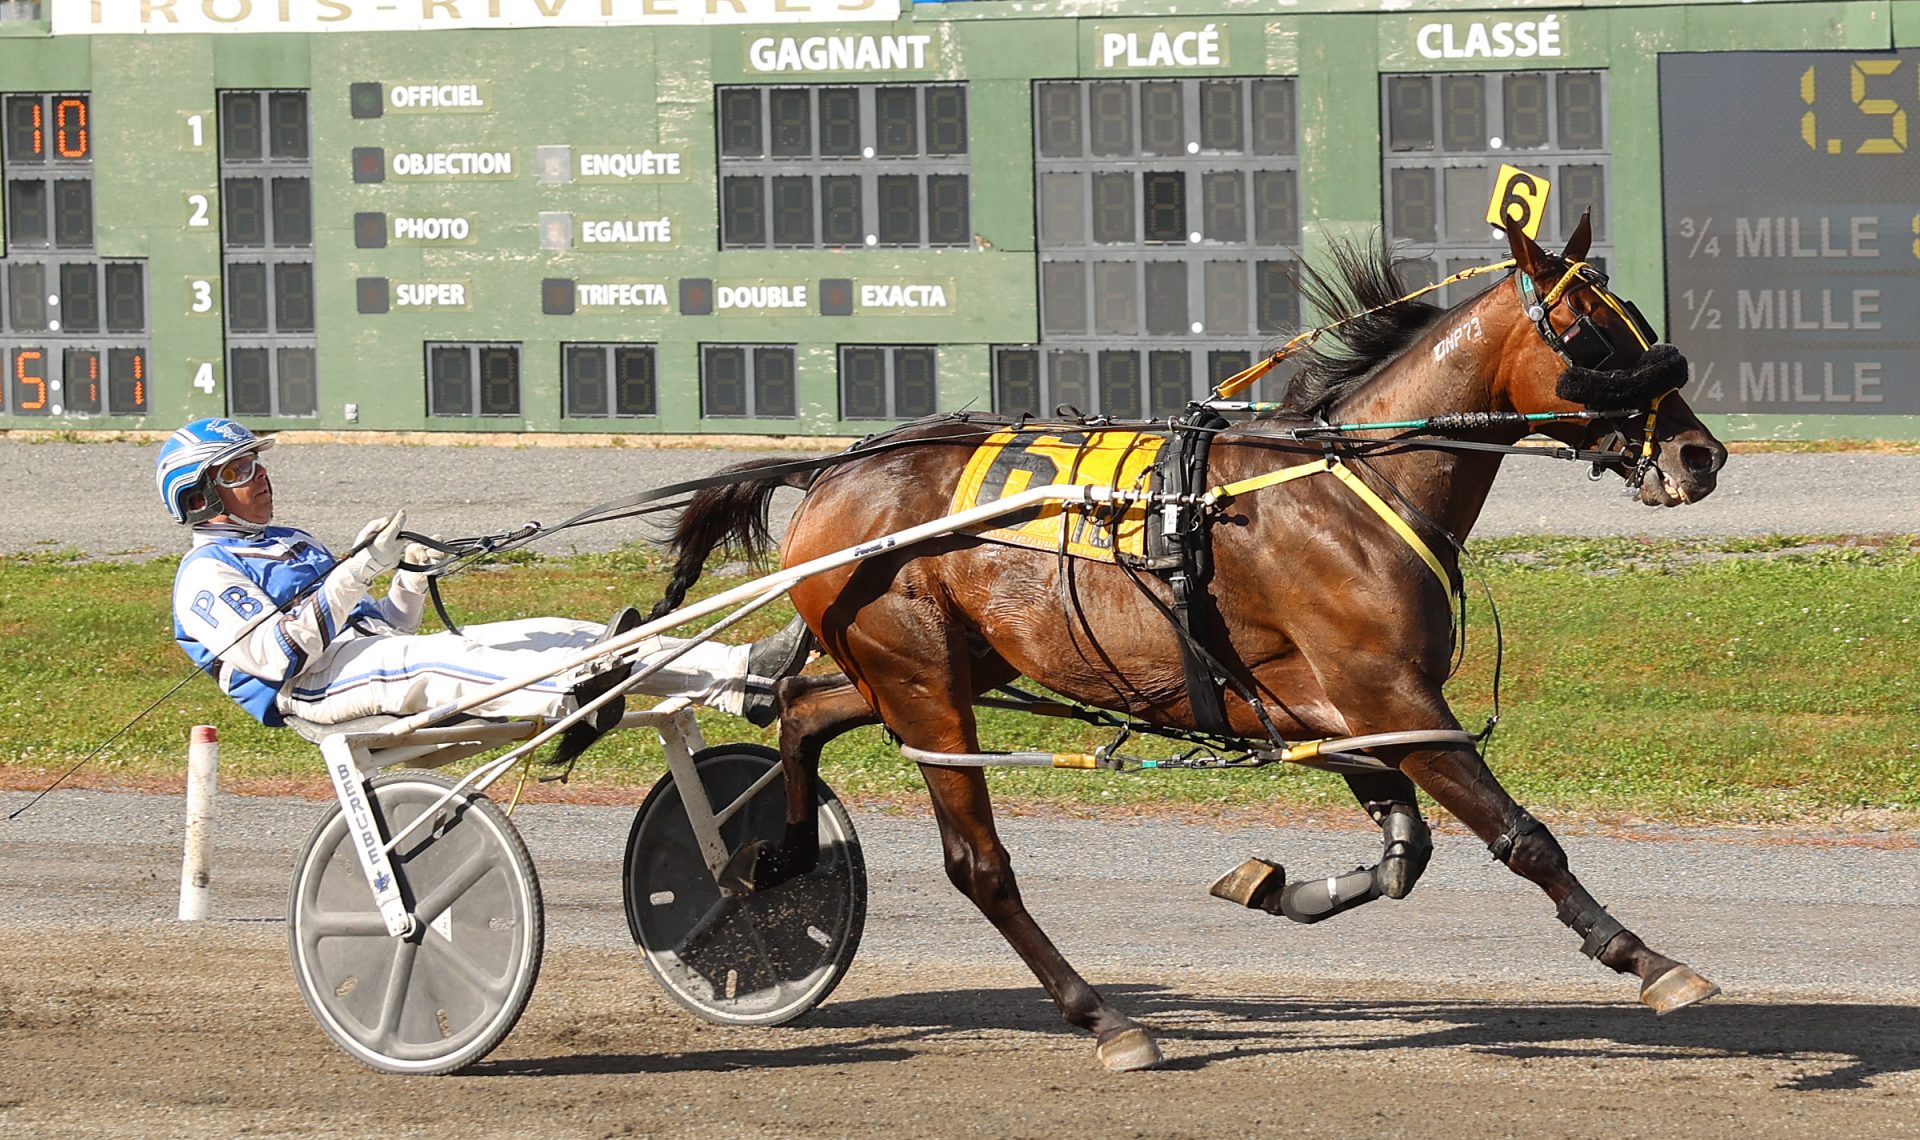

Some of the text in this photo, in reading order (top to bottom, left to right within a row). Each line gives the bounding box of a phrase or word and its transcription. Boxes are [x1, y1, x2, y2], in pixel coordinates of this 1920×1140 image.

[1103, 24, 1220, 68] PLACÉ
[1416, 14, 1561, 59] CLASSÉ
[749, 35, 931, 72] GAGNANT
[390, 84, 484, 108] OFFICIEL
[33, 100, 87, 158] 10
[187, 115, 203, 146] 1
[392, 152, 512, 175] OBJECTION
[580, 150, 681, 177] ENQUÊTE
[188, 195, 209, 226] 2
[1500, 173, 1537, 231] 6
[394, 217, 469, 240] PHOTO
[582, 216, 671, 243] EGALITÉ
[1736, 216, 1881, 257] MILLE
[192, 281, 212, 312] 3
[396, 283, 465, 305] SUPER
[577, 283, 668, 306] TRIFECTA
[717, 285, 807, 308] DOUBLE
[861, 284, 947, 307] EXACTA
[1738, 289, 1882, 329] MILLE
[193, 362, 216, 394] 4
[1739, 362, 1884, 402] MILLE
